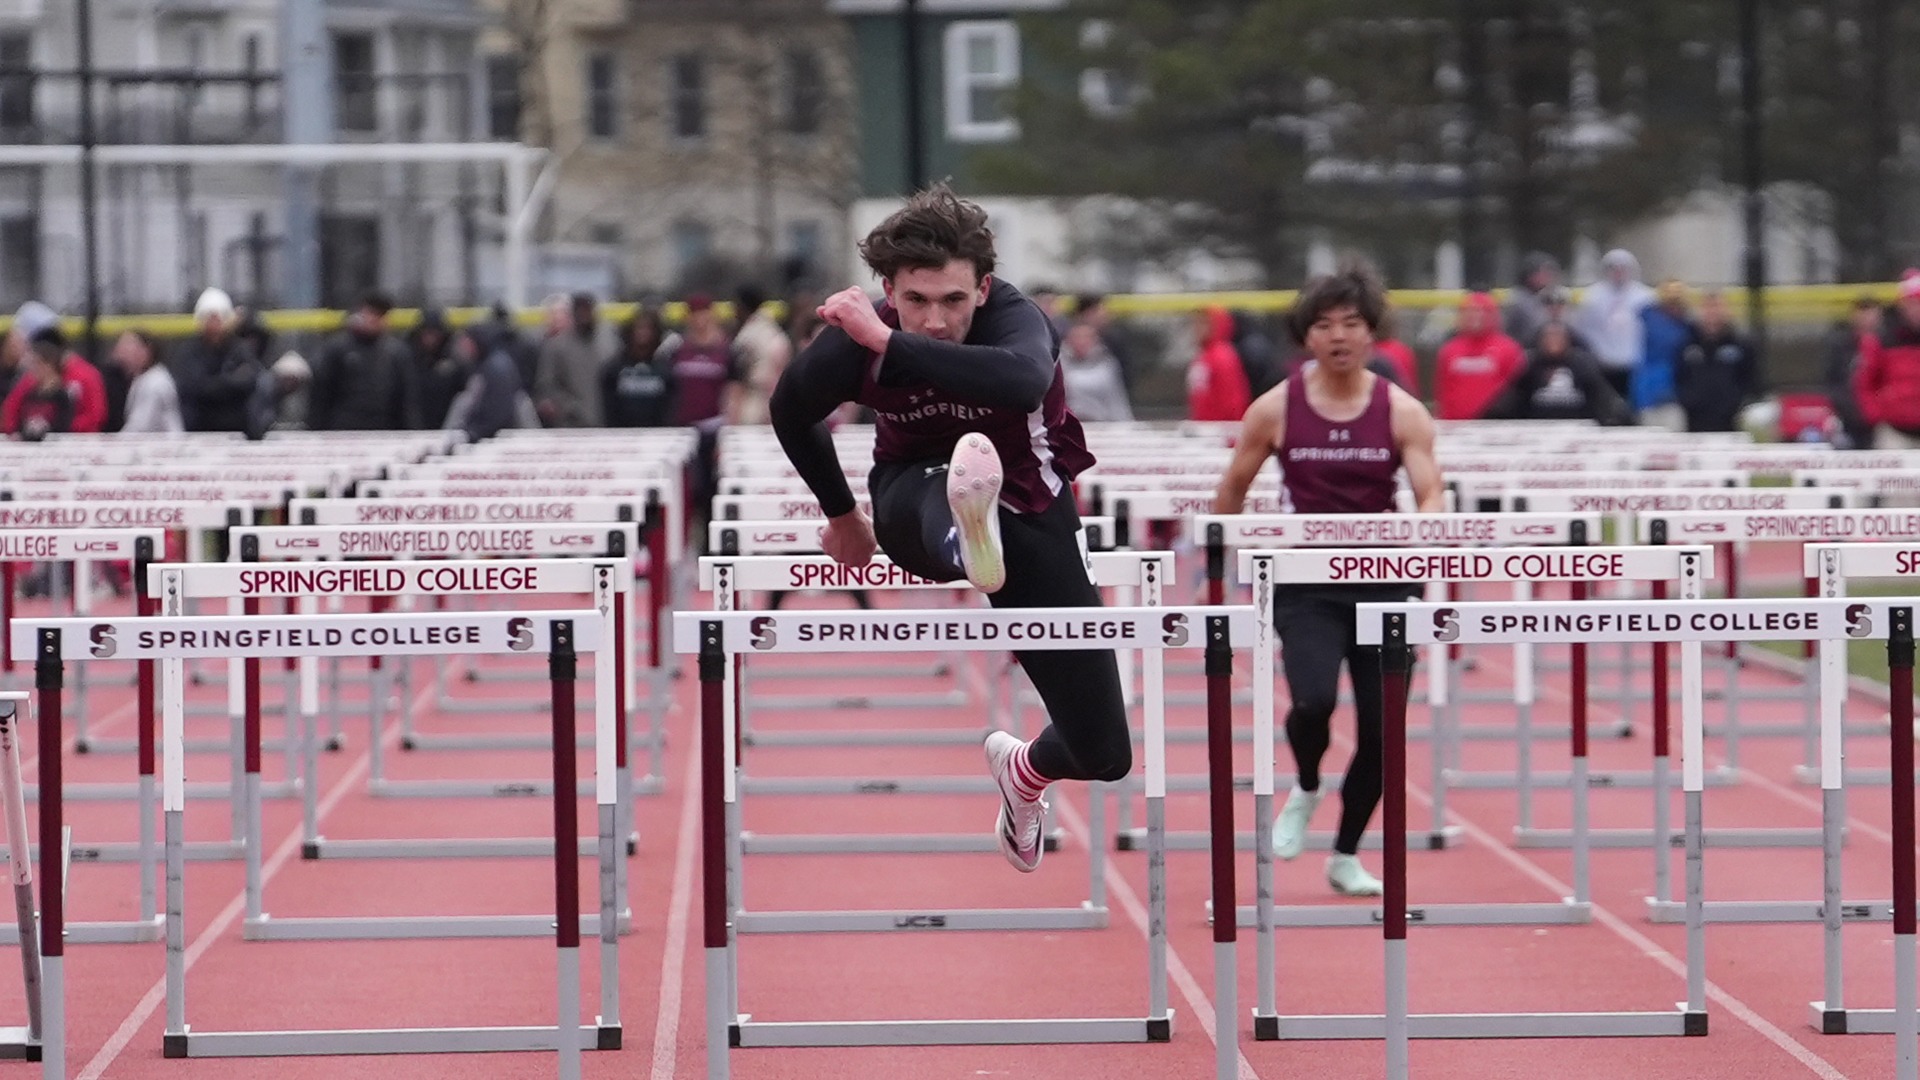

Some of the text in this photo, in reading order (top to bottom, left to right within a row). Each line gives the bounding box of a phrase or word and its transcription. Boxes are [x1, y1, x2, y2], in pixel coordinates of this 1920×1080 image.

[357, 502, 575, 522] SPRINGFIELD COLLEGE
[1302, 519, 1413, 542] SPRINGFIELD
[1418, 518, 1498, 541] COLLEGE
[1744, 514, 1855, 537] SPRINGFIELD
[1861, 513, 1920, 536] COLLE
[73, 540, 120, 552] UCS
[274, 528, 595, 553] UCS SPRINGFIELD COLLEGE UCS
[753, 531, 798, 543] UCS
[1329, 554, 1622, 579] SPRINGFIELD COLLEGE
[239, 567, 537, 593] SPRINGFIELD COLLEGE
[798, 622, 998, 640] SPRINGFIELD
[1007, 621, 1136, 638] COLLEGE
[1481, 615, 1682, 632] SPRINGFIELD
[1690, 613, 1820, 630] COLLEGE
[138, 628, 341, 648] SPRINGFIELD
[350, 626, 480, 645] COLLEGE
